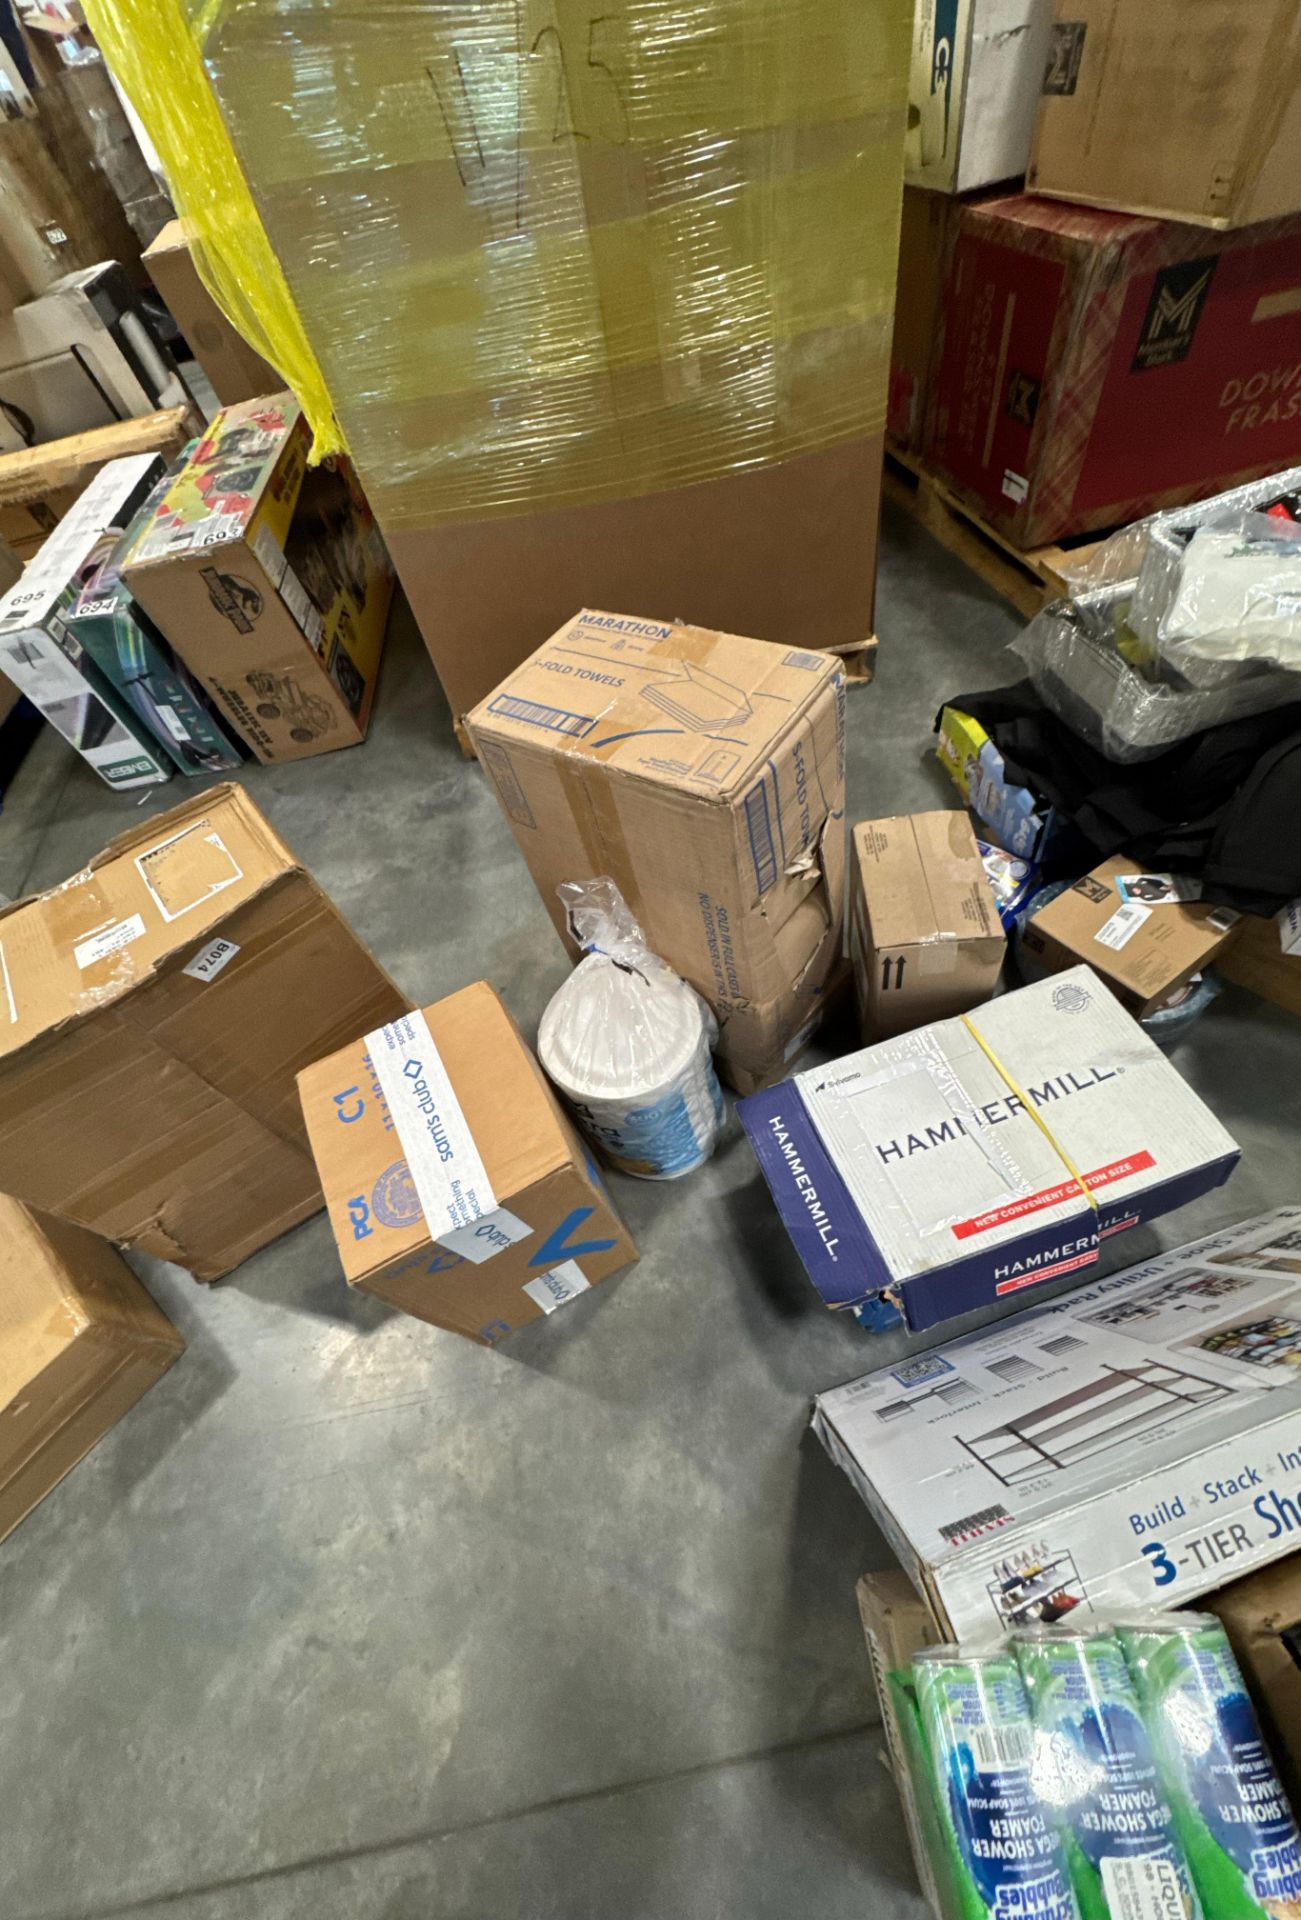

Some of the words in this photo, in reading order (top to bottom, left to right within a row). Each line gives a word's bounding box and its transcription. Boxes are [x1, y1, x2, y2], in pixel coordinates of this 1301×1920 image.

[1225, 391, 1301, 434] FRAS
[203, 527, 242, 546] 693
[10, 590, 46, 606] 695
[79, 600, 116, 615] 694
[579, 614, 673, 639] MARATHON
[573, 668, 626, 688] TOWELS
[792, 741, 809, 806] S-FOLD
[698, 891, 710, 909] NO
[714, 904, 731, 933] SOLD
[197, 941, 230, 973] B074
[828, 1072, 861, 1088] Sylvamo
[333, 1085, 365, 1124] C1
[414, 1078, 437, 1116] club
[426, 1114, 455, 1163] sam's
[768, 1115, 839, 1257] HAMMERMILL
[973, 1211, 999, 1228] NEW
[1001, 1190, 1064, 1218] CONVENIENT
[1108, 1162, 1133, 1181] SIZE
[347, 1195, 374, 1241] PCA
[1079, 1253, 1099, 1265] CART
[1179, 1238, 1233, 1260] Shoe
[1099, 1265, 1165, 1295] Utility
[1051, 1293, 1099, 1315] Rack
[1036, 1366, 1070, 1381] Build
[992, 1383, 1026, 1399] Stack
[926, 1400, 982, 1425] Interlock
[1129, 1495, 1187, 1536] Build
[1203, 1465, 1263, 1504] Stack
[1140, 1523, 1254, 1587] 3-TIER
[988, 1796, 1009, 1809] SOAP
[1099, 1788, 1157, 1811] FOAMER
[1080, 1811, 1147, 1833] SHOWER
[1218, 1801, 1282, 1824] SHOWER
[990, 1815, 1046, 1838] FOAMER
[972, 1838, 1035, 1860] SHOWER
[1253, 1843, 1301, 1871] bbles
[1000, 1874, 1063, 1906] Bubbles
[1253, 1870, 1301, 1899] bbing
